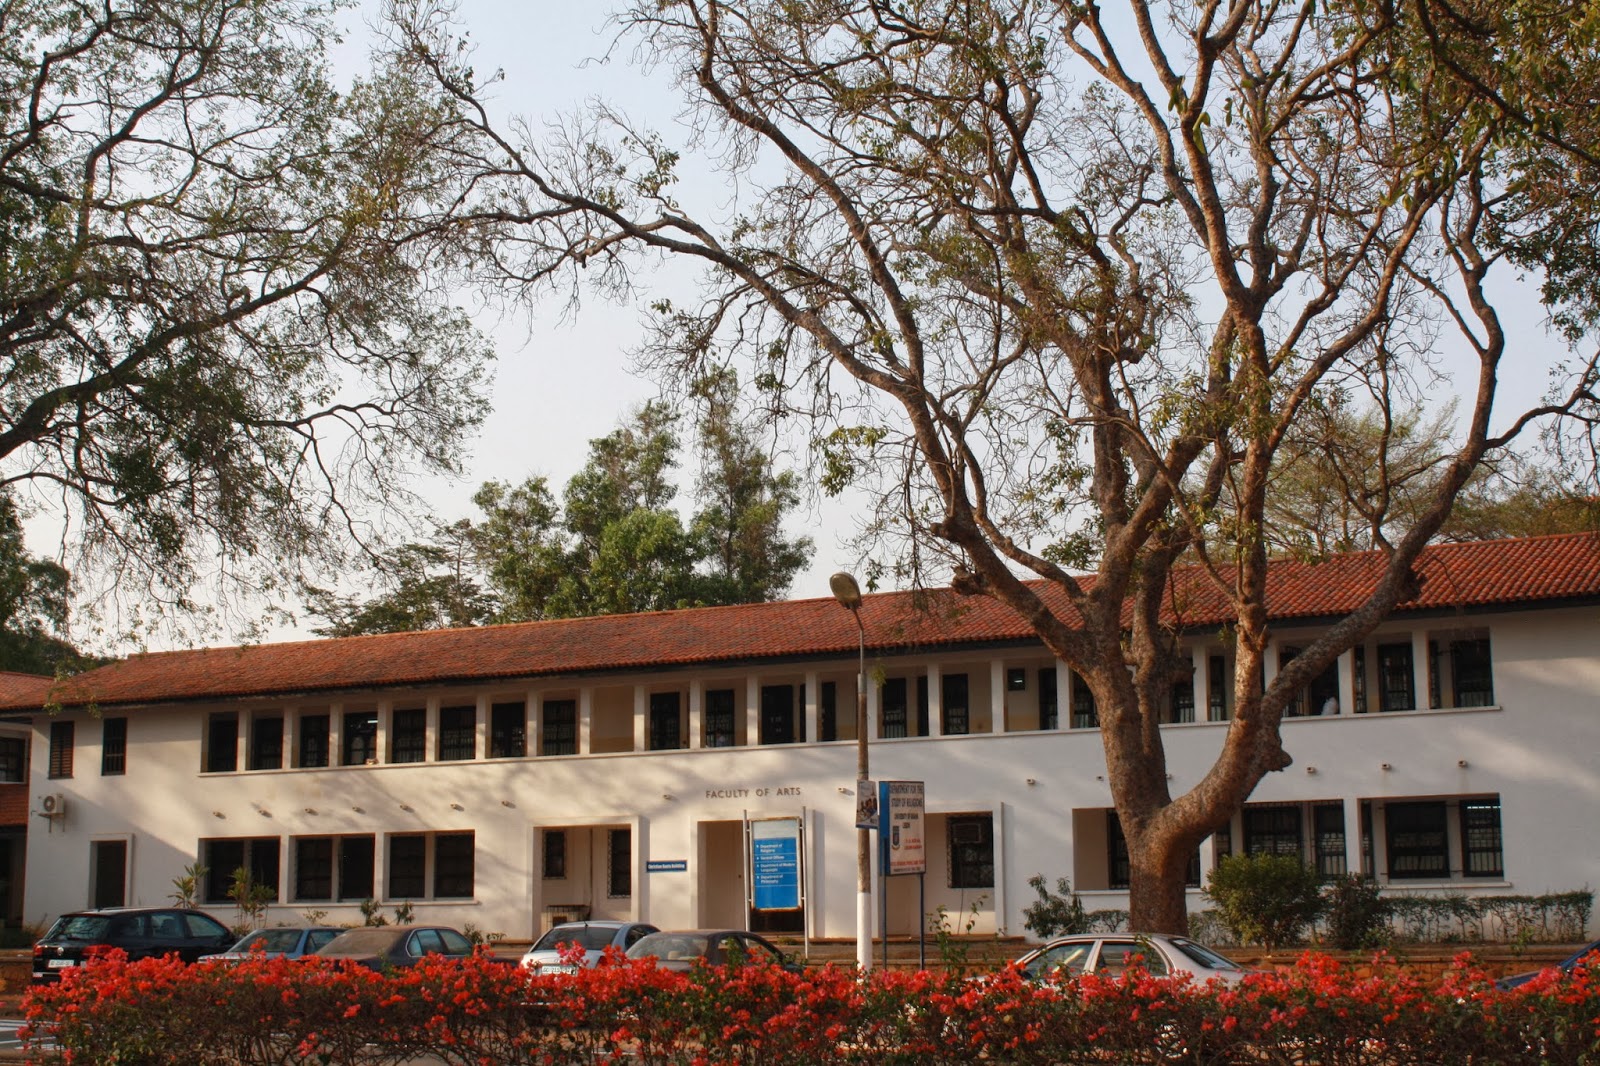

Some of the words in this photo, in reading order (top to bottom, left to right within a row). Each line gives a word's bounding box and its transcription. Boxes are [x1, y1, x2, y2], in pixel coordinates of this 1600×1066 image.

[705, 789, 749, 799] FACULTY
[755, 788, 769, 797] OF
[776, 787, 801, 796] ARTS
